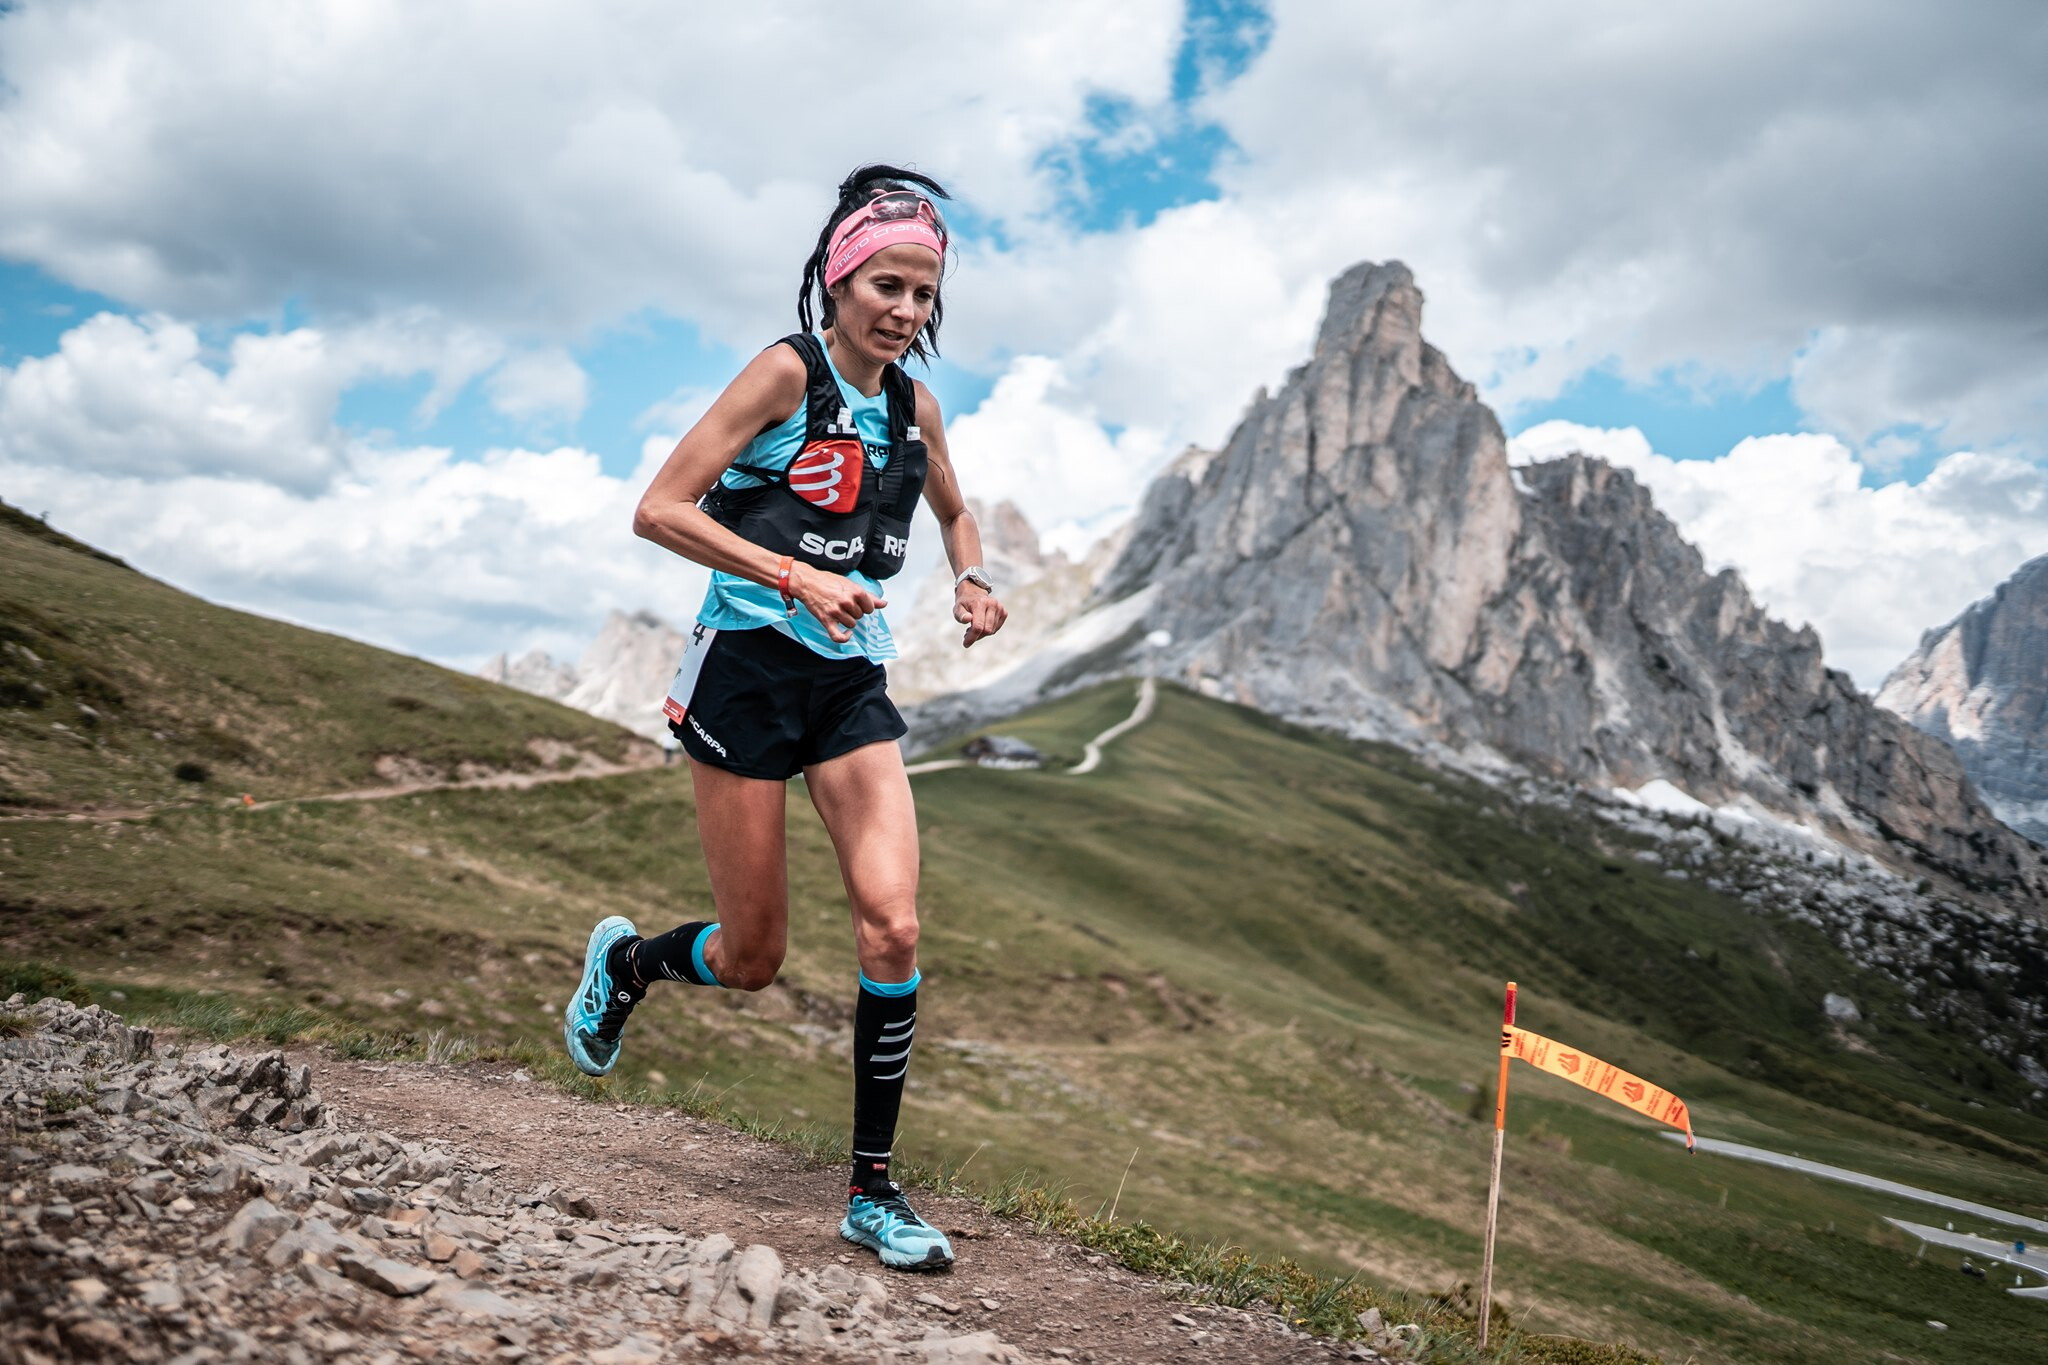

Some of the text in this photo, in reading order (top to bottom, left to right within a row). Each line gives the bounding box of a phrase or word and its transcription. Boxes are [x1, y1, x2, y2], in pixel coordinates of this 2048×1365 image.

[834, 237, 870, 272] micro
[883, 534, 908, 557] RP
[692, 622, 706, 646] 4
[688, 714, 727, 758] SCARPA
